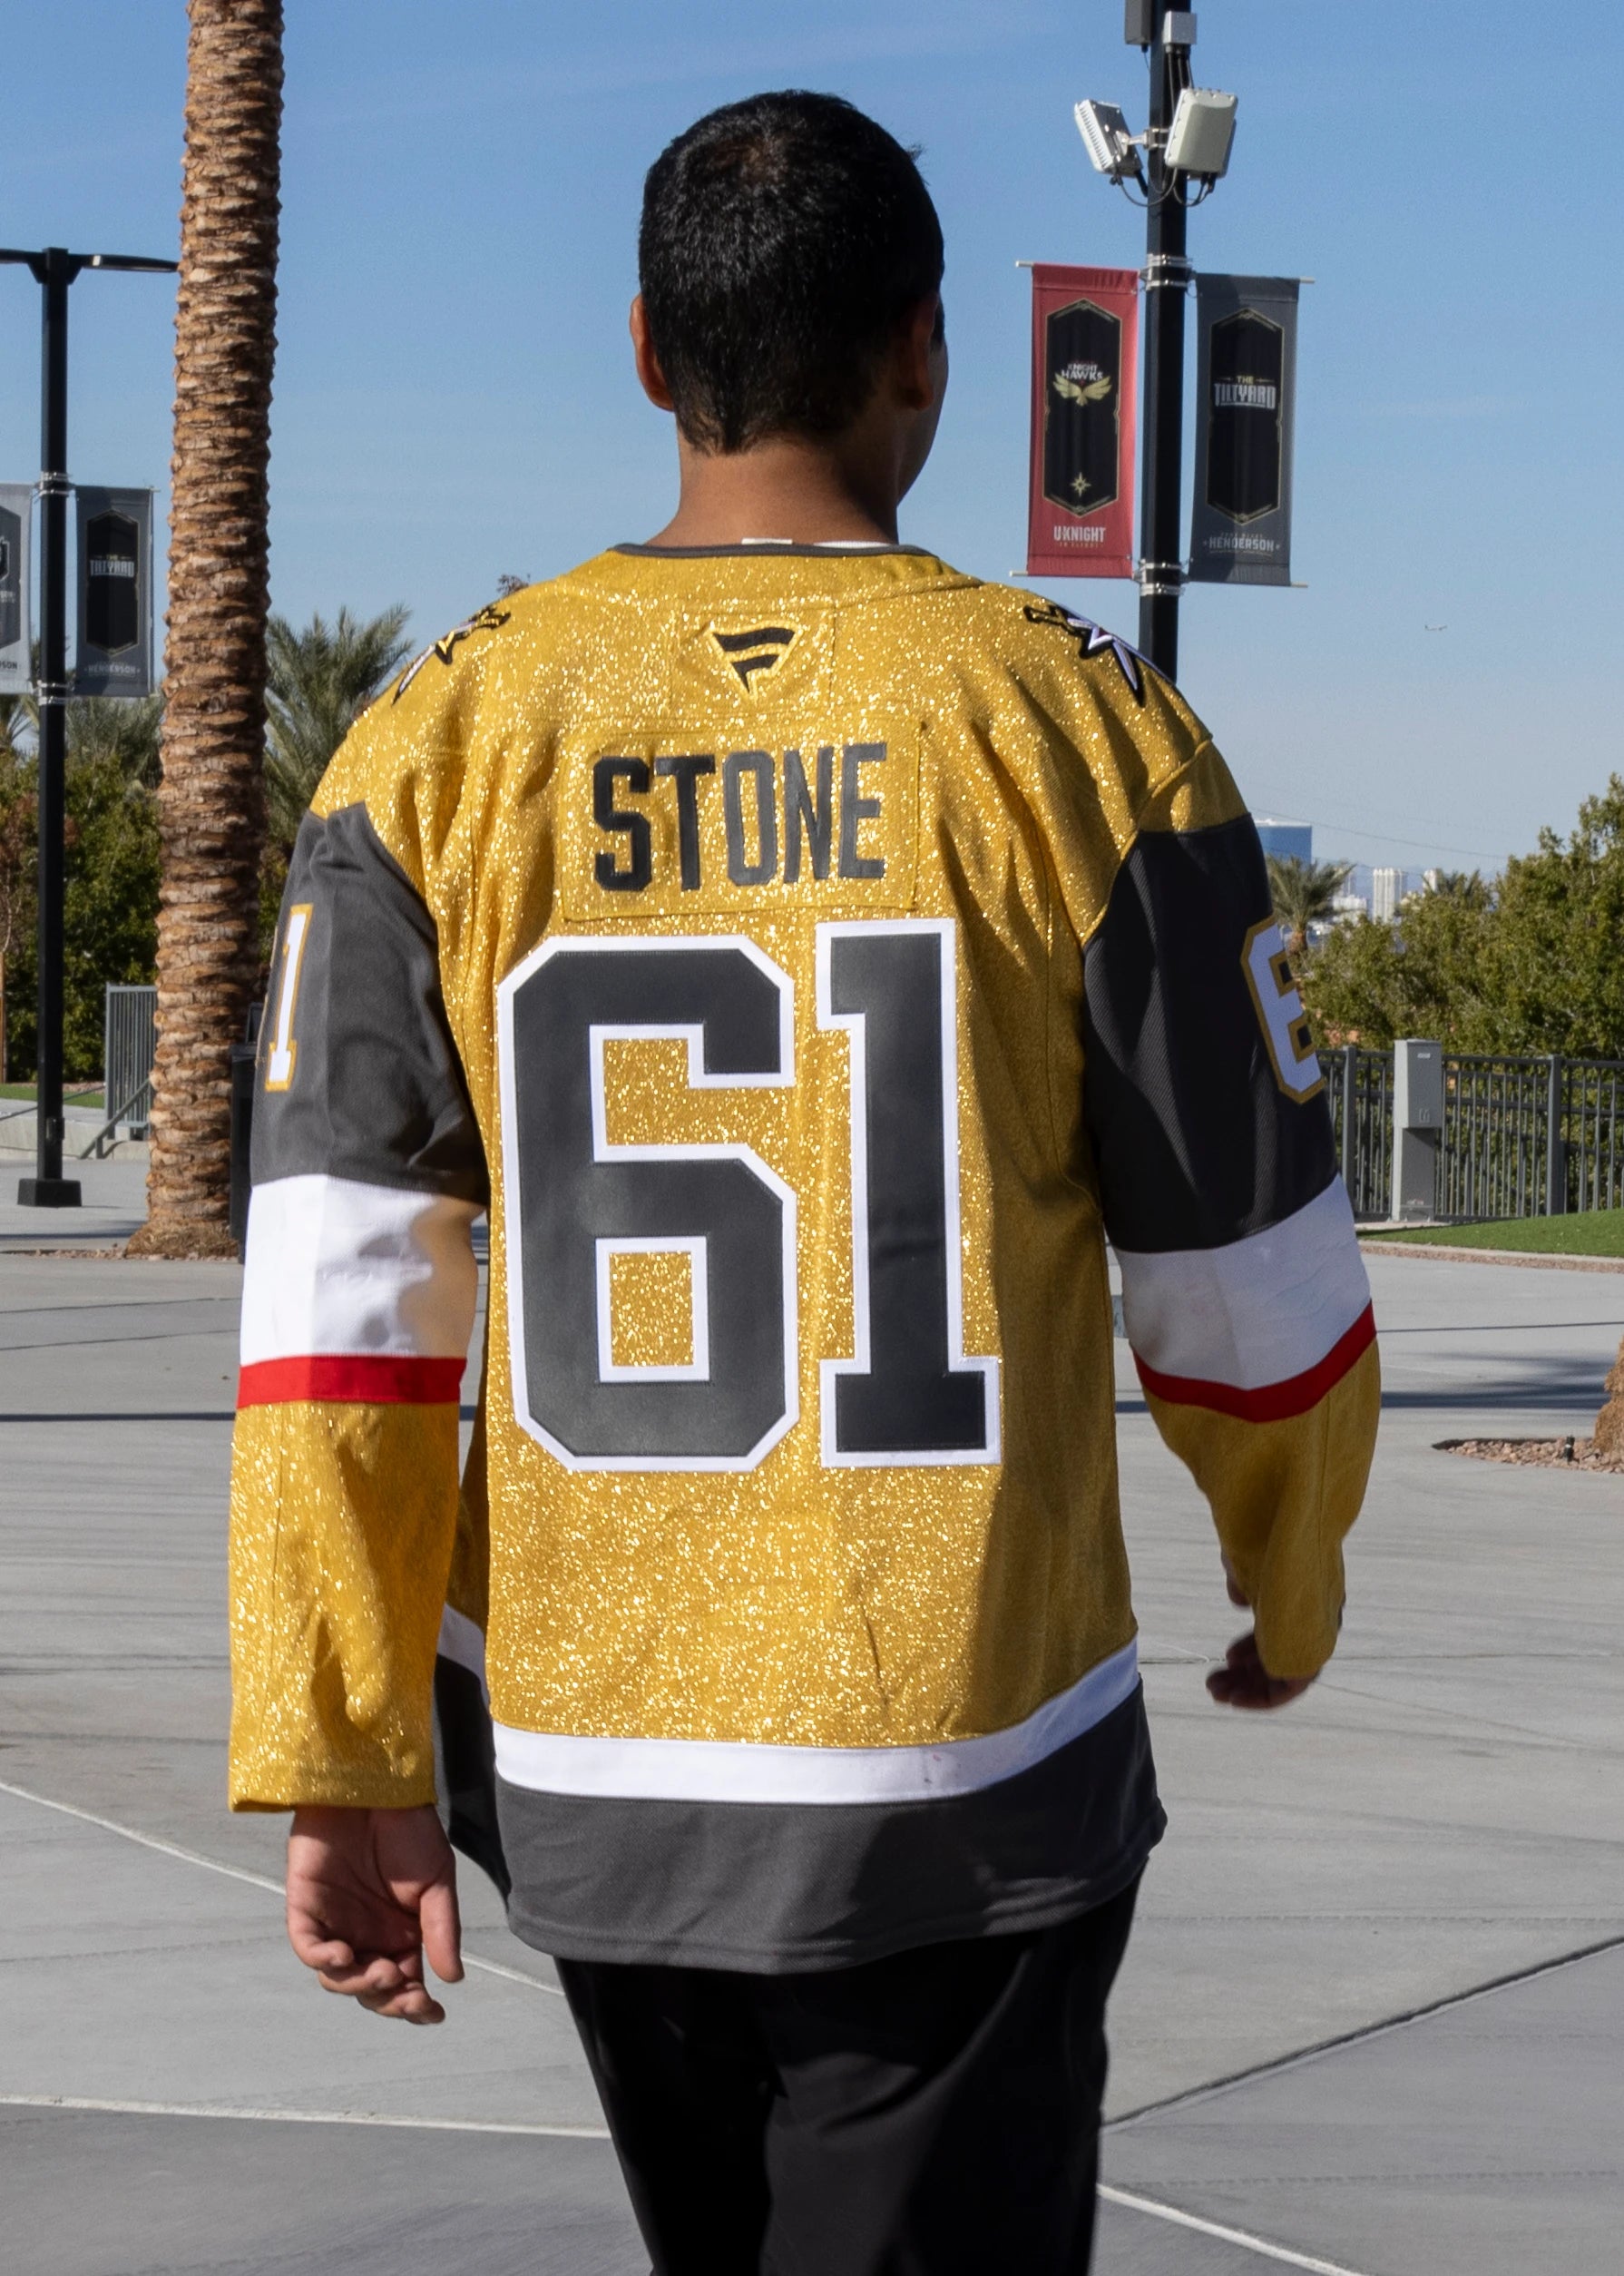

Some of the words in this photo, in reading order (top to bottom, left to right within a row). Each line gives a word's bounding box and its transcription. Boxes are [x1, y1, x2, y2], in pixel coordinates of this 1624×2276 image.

[1061, 369, 1103, 381] HAWKS
[1237, 375, 1254, 384] THE
[1214, 383, 1277, 410] TILTYARD
[1208, 536, 1275, 552] HENDERSON
[592, 741, 887, 892] STONE
[496, 917, 1003, 1473] 61
